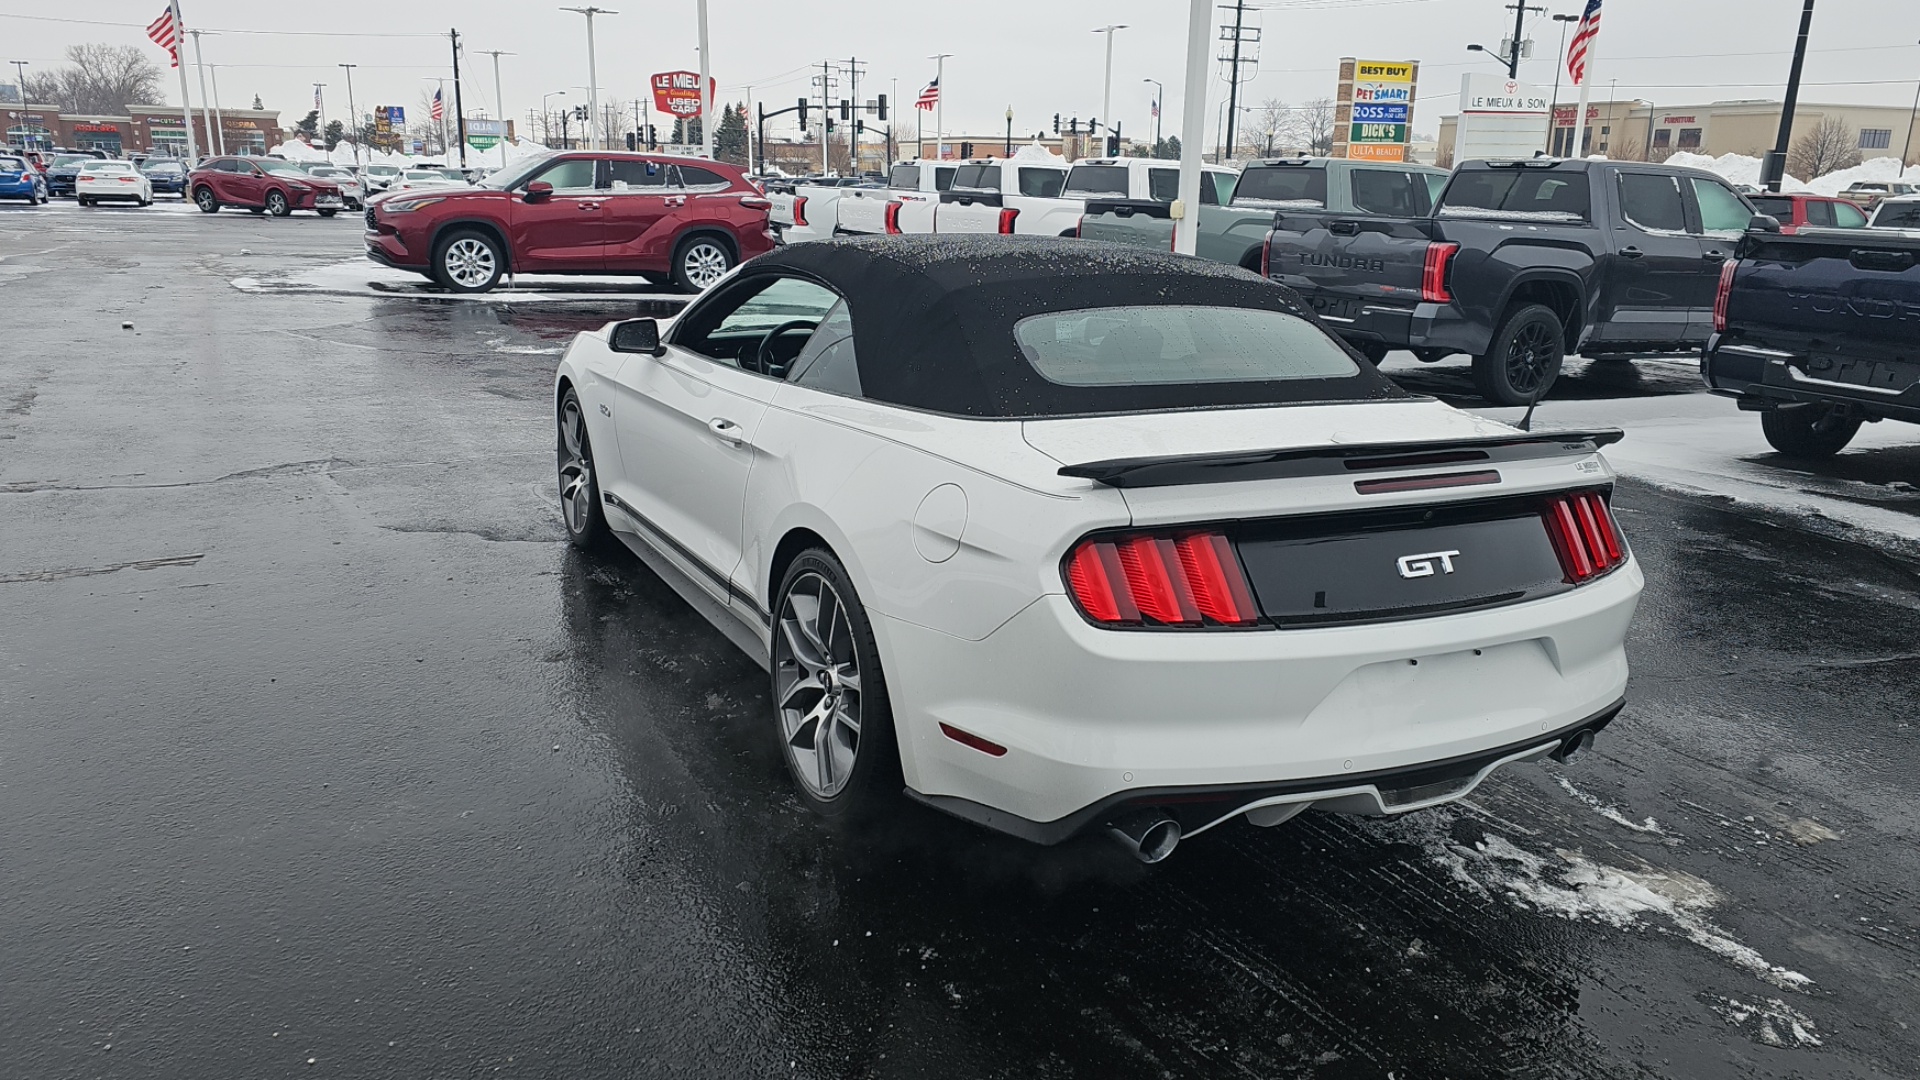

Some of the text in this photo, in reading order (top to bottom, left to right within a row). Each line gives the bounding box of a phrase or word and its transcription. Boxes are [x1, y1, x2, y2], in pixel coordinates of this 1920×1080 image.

[1360, 66, 1408, 76] BEST BUY
[656, 73, 700, 88] LE MIEU
[667, 98, 700, 106] USED
[1472, 97, 1546, 108] LE MIEUX & SON
[671, 106, 697, 114] CARS
[1354, 107, 1385, 118] ROSS
[1362, 124, 1395, 137] DICK'S
[1352, 145, 1402, 157] ULTA BEAUTY
[1299, 253, 1384, 273] TUNDRA
[1395, 550, 1460, 579] GT
